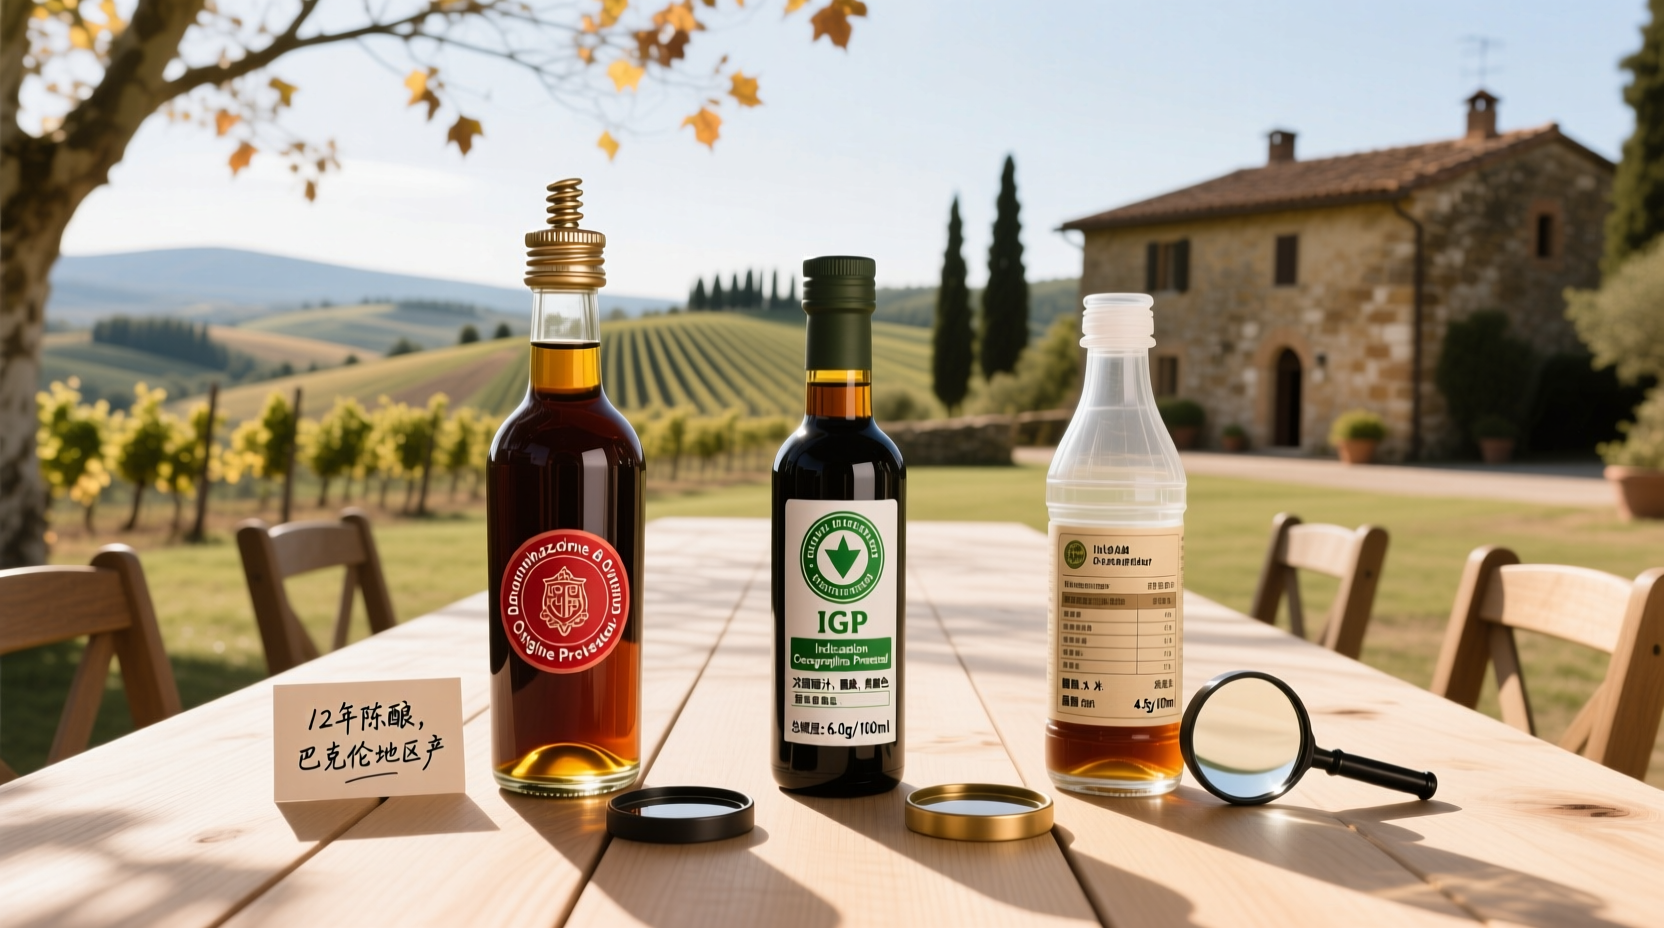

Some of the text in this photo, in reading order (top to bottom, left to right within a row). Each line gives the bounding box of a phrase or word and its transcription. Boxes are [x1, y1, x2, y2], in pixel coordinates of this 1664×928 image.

[817, 610, 868, 634] IGP
[299, 734, 444, 771] 巴克伦地区产
